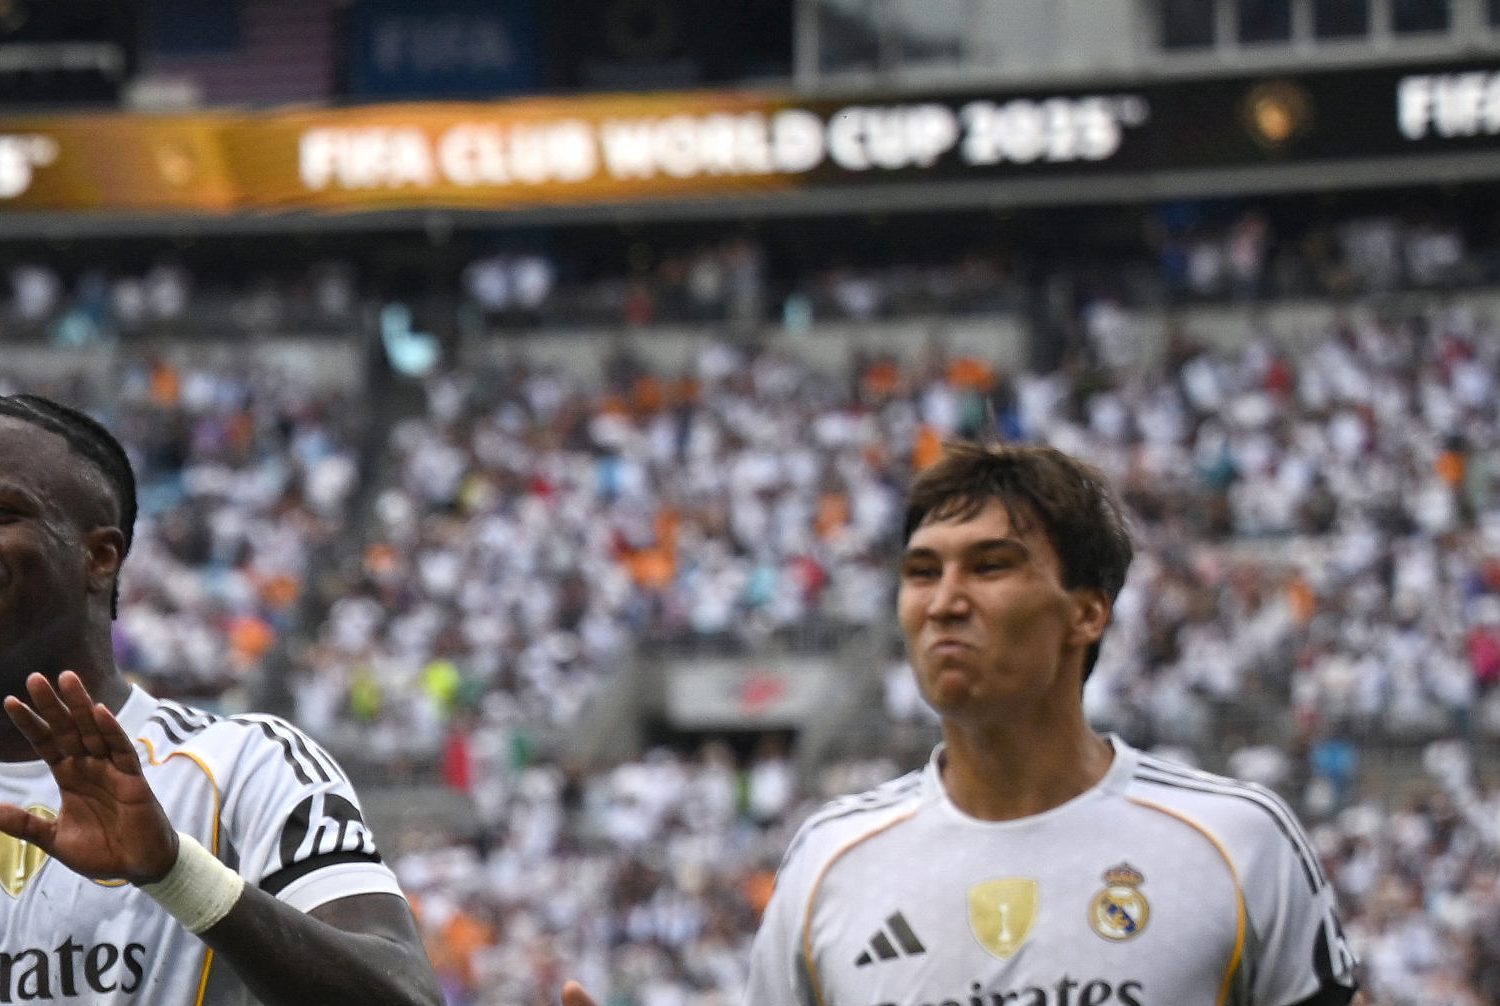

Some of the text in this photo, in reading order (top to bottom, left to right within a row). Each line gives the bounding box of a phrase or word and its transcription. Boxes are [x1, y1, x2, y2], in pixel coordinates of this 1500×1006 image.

[300, 126, 435, 190] FIFA
[438, 122, 598, 185] CLUB
[600, 110, 824, 180] WORLD
[827, 105, 959, 170] CUP
